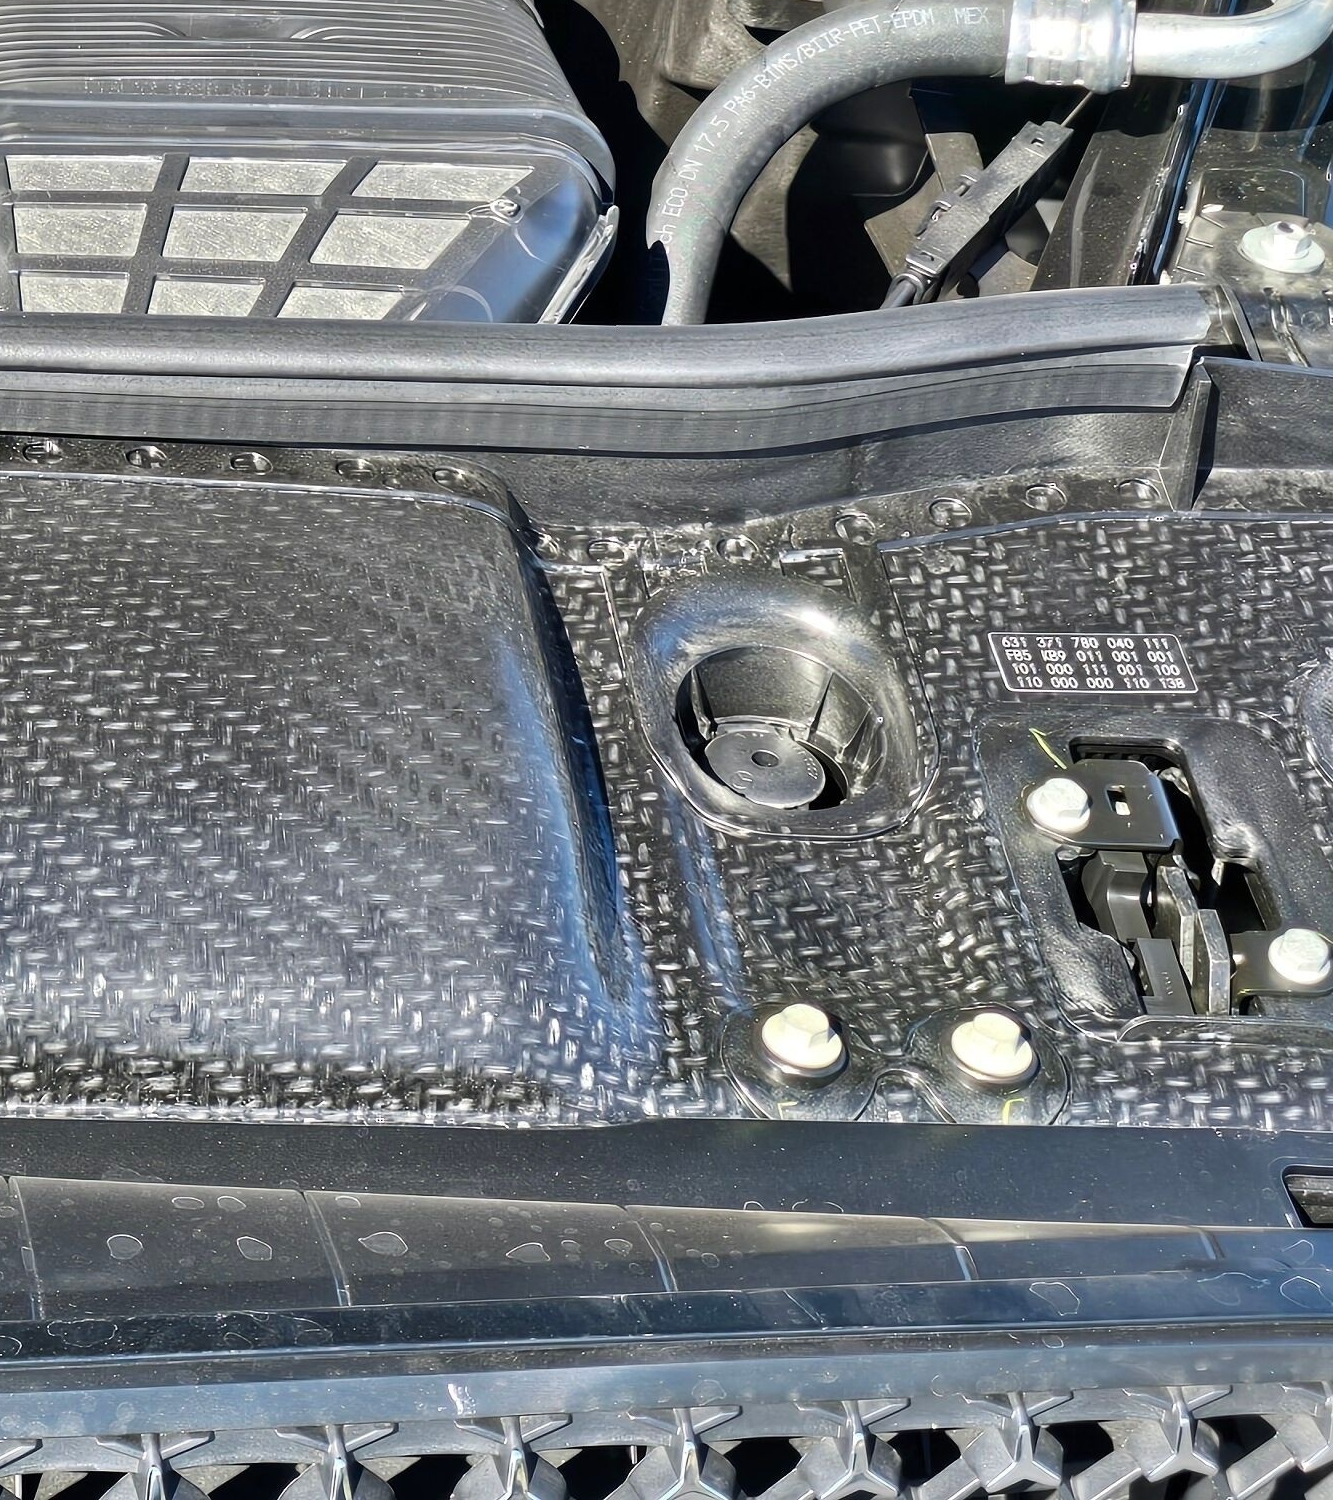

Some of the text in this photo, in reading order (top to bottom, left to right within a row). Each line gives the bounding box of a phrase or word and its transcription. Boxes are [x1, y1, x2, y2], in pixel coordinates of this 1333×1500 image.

[662, 187, 689, 218] ECO
[694, 114, 731, 155] 17,5
[953, 7, 989, 27] MEX
[1001, 636, 1027, 649] 631
[1071, 636, 1098, 649] 780
[1143, 636, 1169, 649] 111
[1076, 649, 1102, 662] 011
[1112, 649, 1138, 662] 001
[1147, 649, 1174, 662] 001
[1011, 663, 1180, 675] 101 000 111 001 100
[1017, 676, 1043, 689] 110
[1051, 676, 1078, 689] 000
[1086, 676, 1114, 689] 000
[1123, 676, 1149, 689] 110
